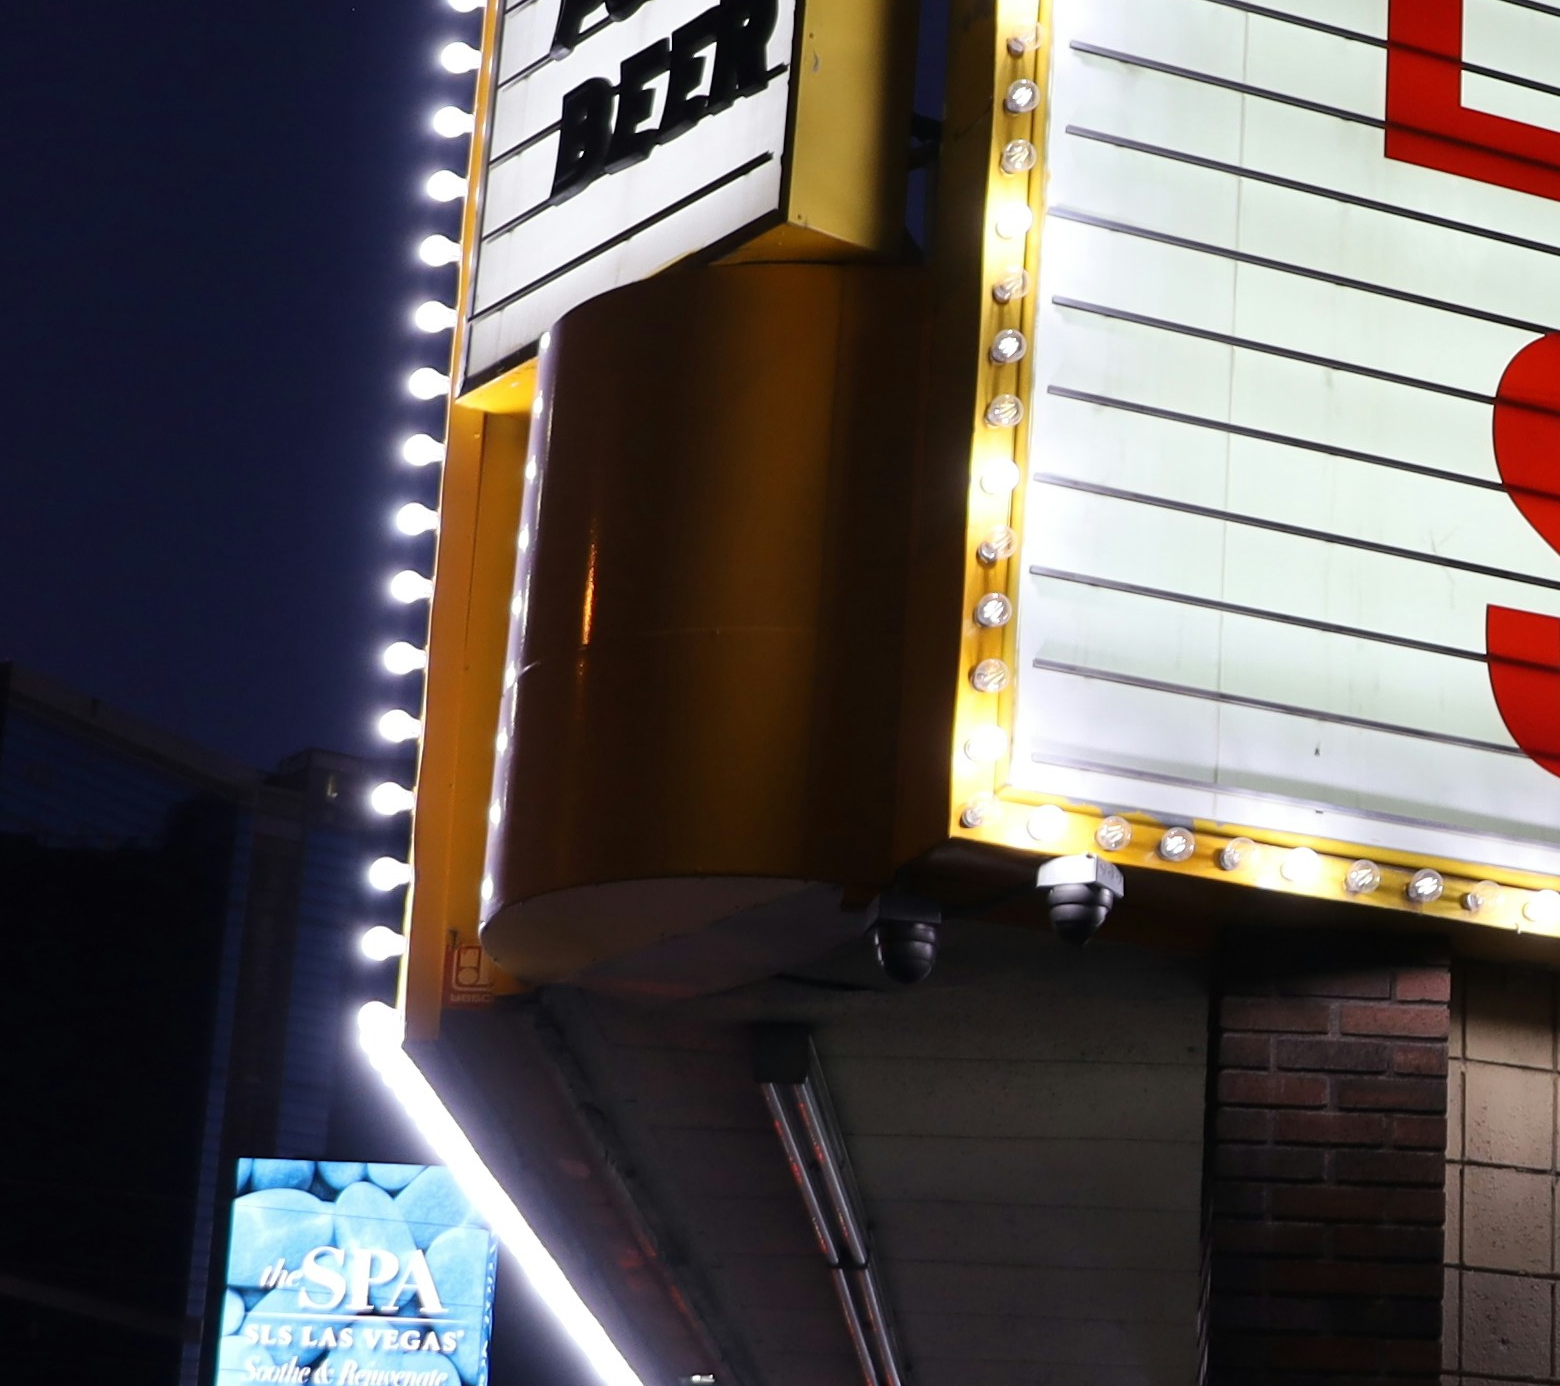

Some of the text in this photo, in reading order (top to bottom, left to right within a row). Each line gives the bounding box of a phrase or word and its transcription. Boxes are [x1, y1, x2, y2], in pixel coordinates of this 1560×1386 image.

[260, 1245, 449, 1313] the SPA
[244, 1324, 458, 1353] SLS LAS VEGAS
[242, 1354, 311, 1385] Soothe
[312, 1360, 334, 1385] &
